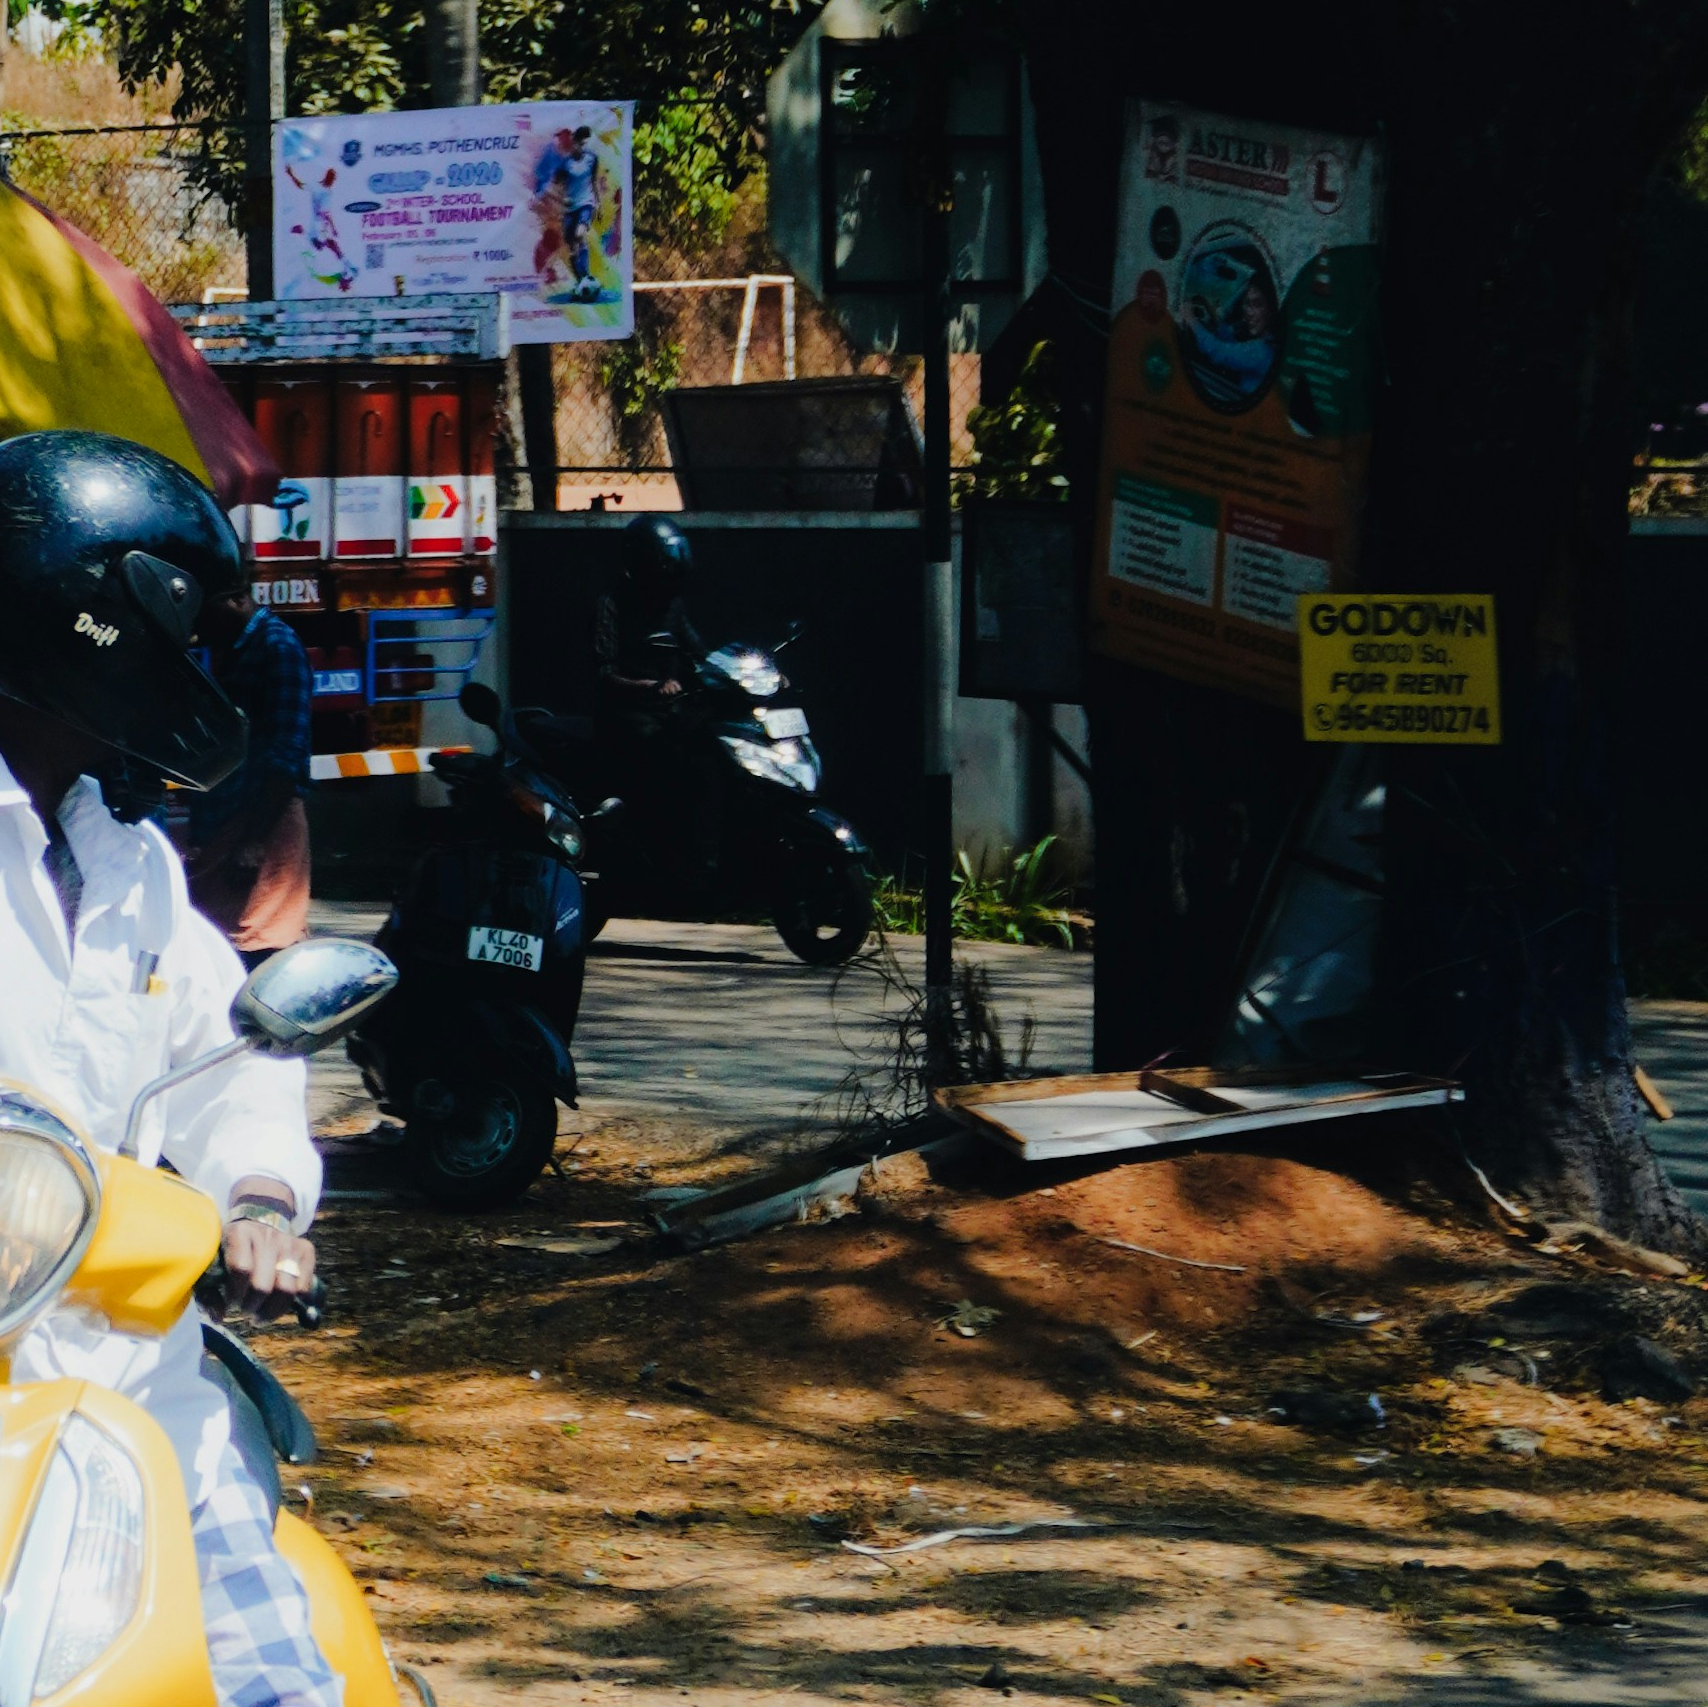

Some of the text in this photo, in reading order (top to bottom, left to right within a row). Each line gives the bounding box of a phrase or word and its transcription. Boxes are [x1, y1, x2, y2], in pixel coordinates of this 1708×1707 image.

[1188, 130, 1268, 170] ASTER
[447, 162, 503, 187] 2026
[1314, 160, 1337, 204] L
[441, 193, 485, 206] SCHOOL
[430, 205, 514, 224] TOURNAMENT
[251, 578, 320, 605] HORN
[73, 612, 120, 647] Drift
[1310, 603, 1487, 637] GODOWN
[1331, 673, 1469, 696] FOR RENT
